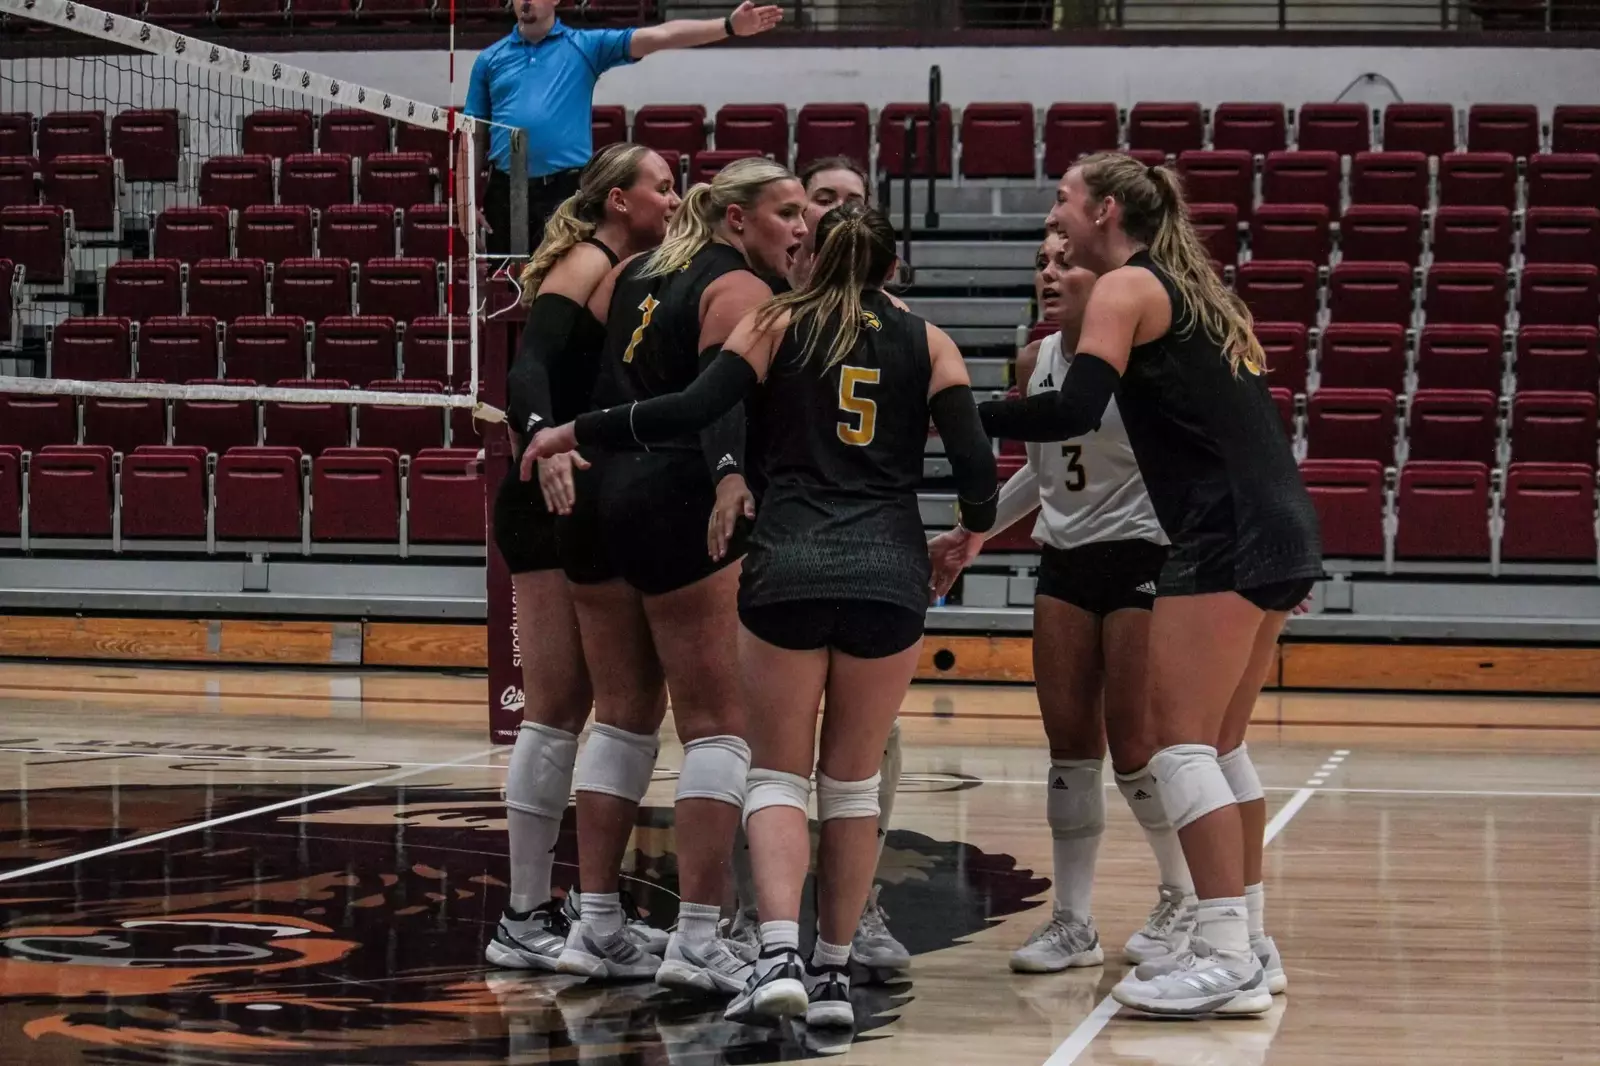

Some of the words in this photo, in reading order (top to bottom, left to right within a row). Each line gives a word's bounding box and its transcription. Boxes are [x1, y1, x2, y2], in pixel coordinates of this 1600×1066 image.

[836, 364, 881, 447] 5
[1061, 444, 1087, 492] 3
[56, 739, 338, 755] COURT
